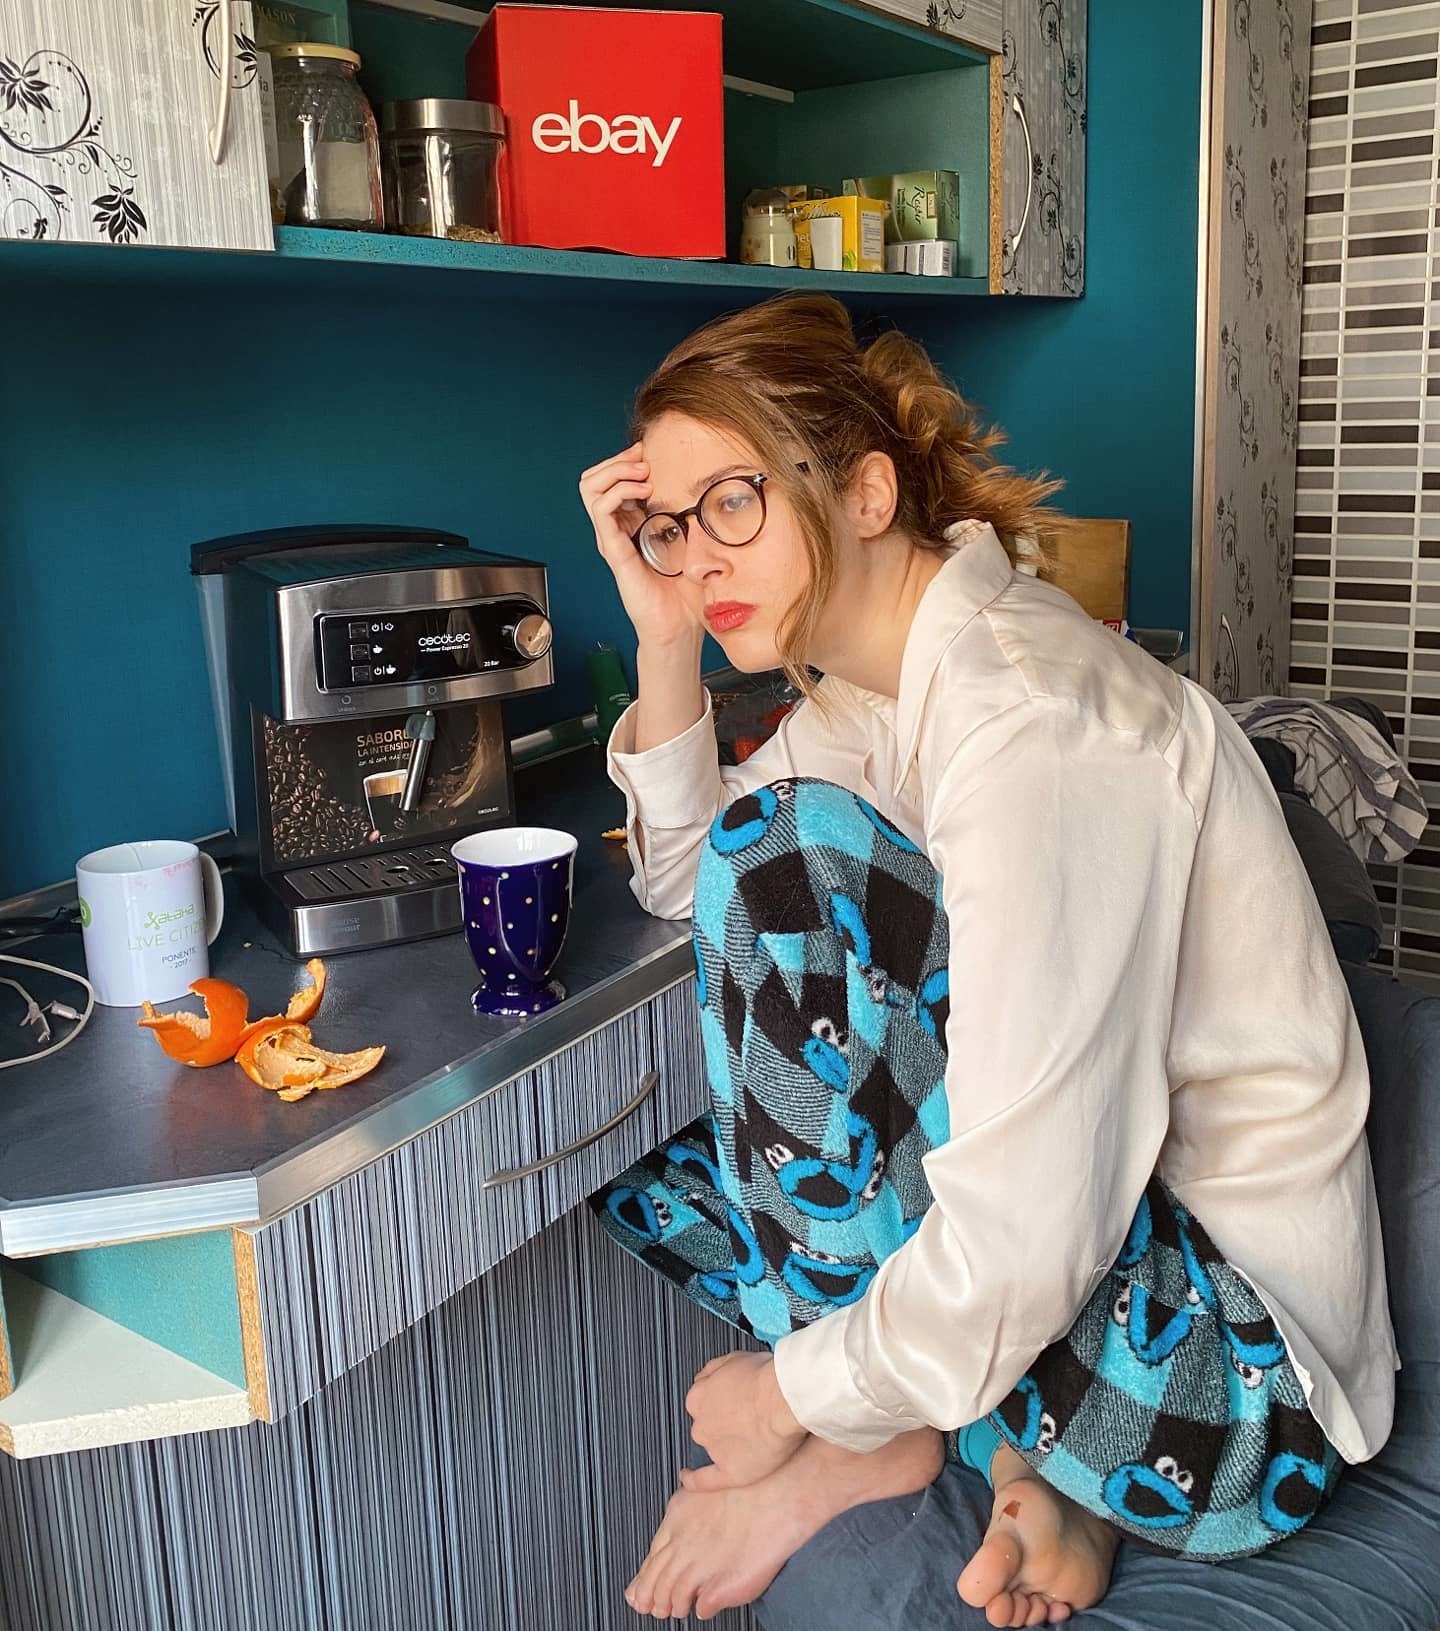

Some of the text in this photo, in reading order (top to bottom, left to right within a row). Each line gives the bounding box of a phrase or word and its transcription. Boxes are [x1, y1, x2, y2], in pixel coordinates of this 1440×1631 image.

[531, 99, 682, 167] ebay
[417, 632, 471, 647] cecotec
[357, 748, 369, 758] LA
[127, 932, 164, 952] LIVE
